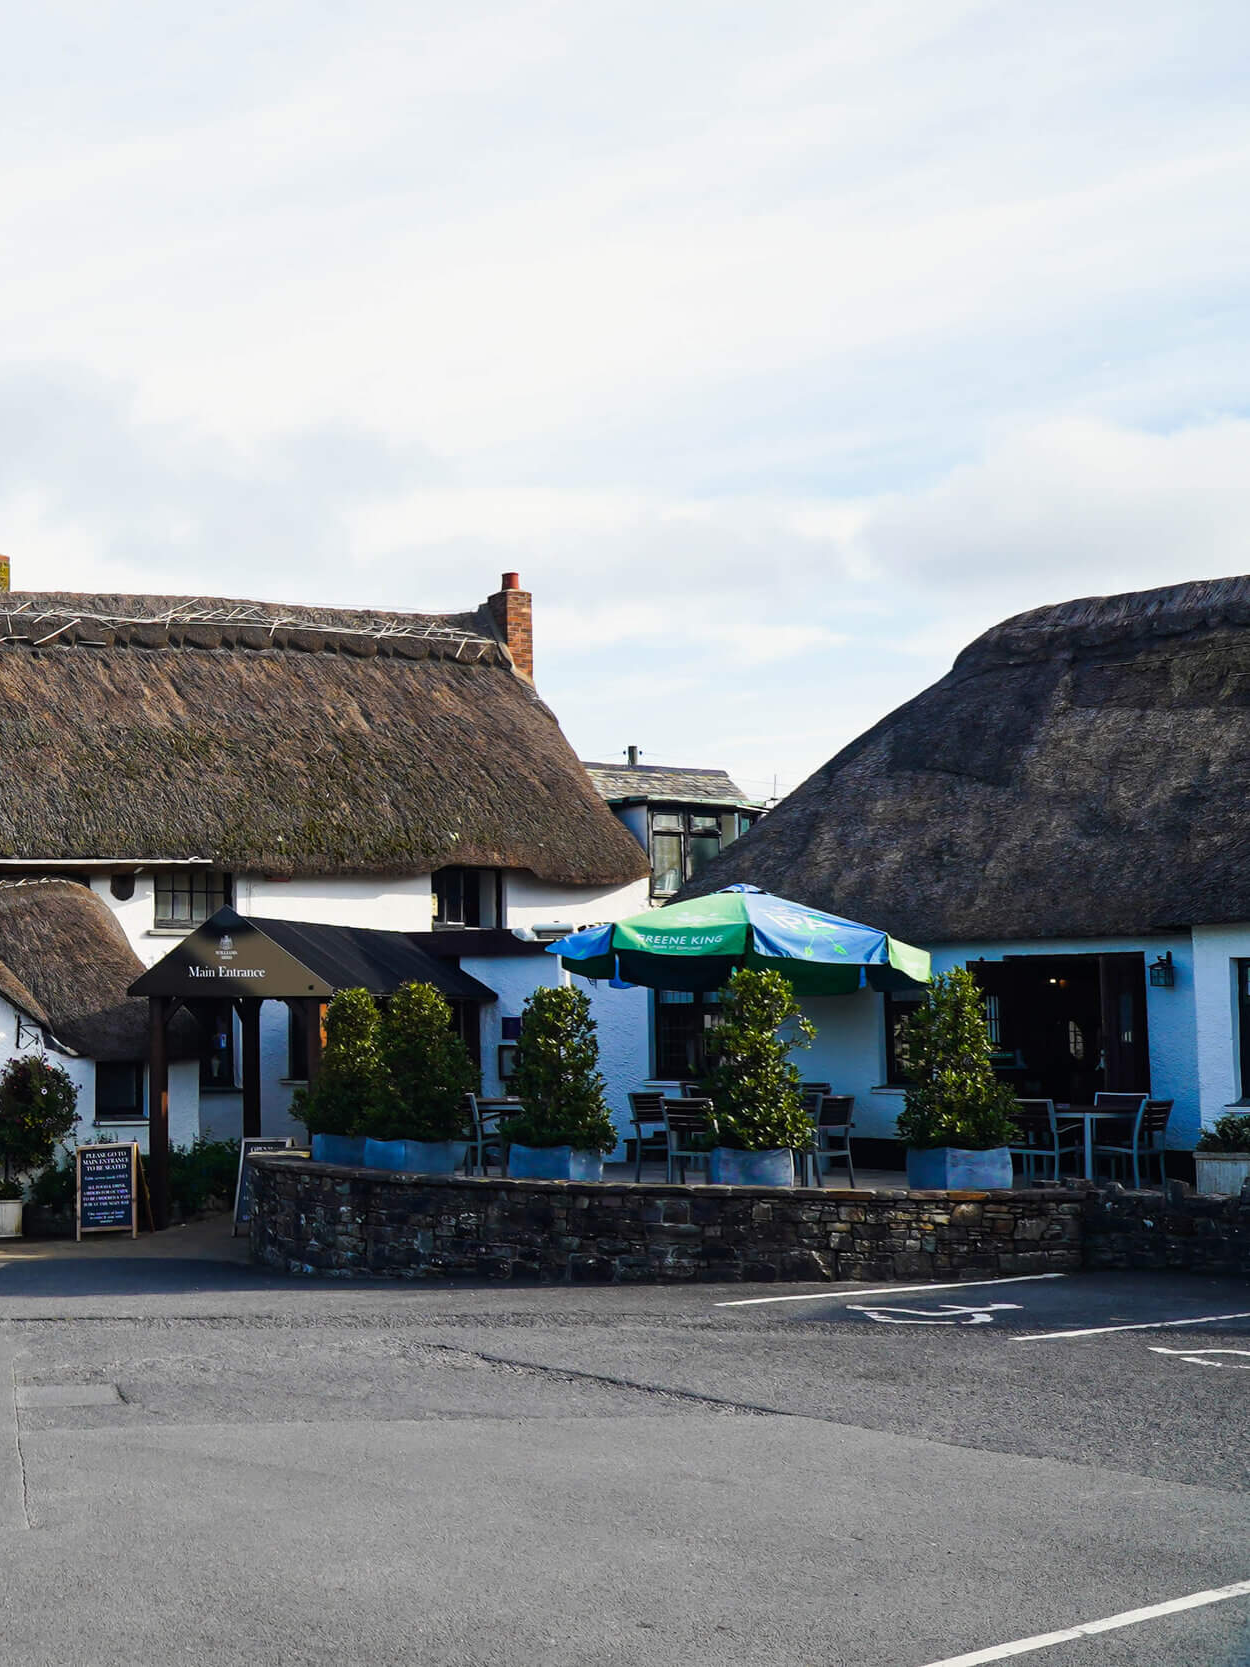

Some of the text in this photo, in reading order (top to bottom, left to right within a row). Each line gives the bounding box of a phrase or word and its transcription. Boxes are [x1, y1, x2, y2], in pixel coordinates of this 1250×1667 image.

[765, 913, 839, 931] IPA
[691, 934, 724, 945] KING
[188, 966, 266, 978] Main Entrance
